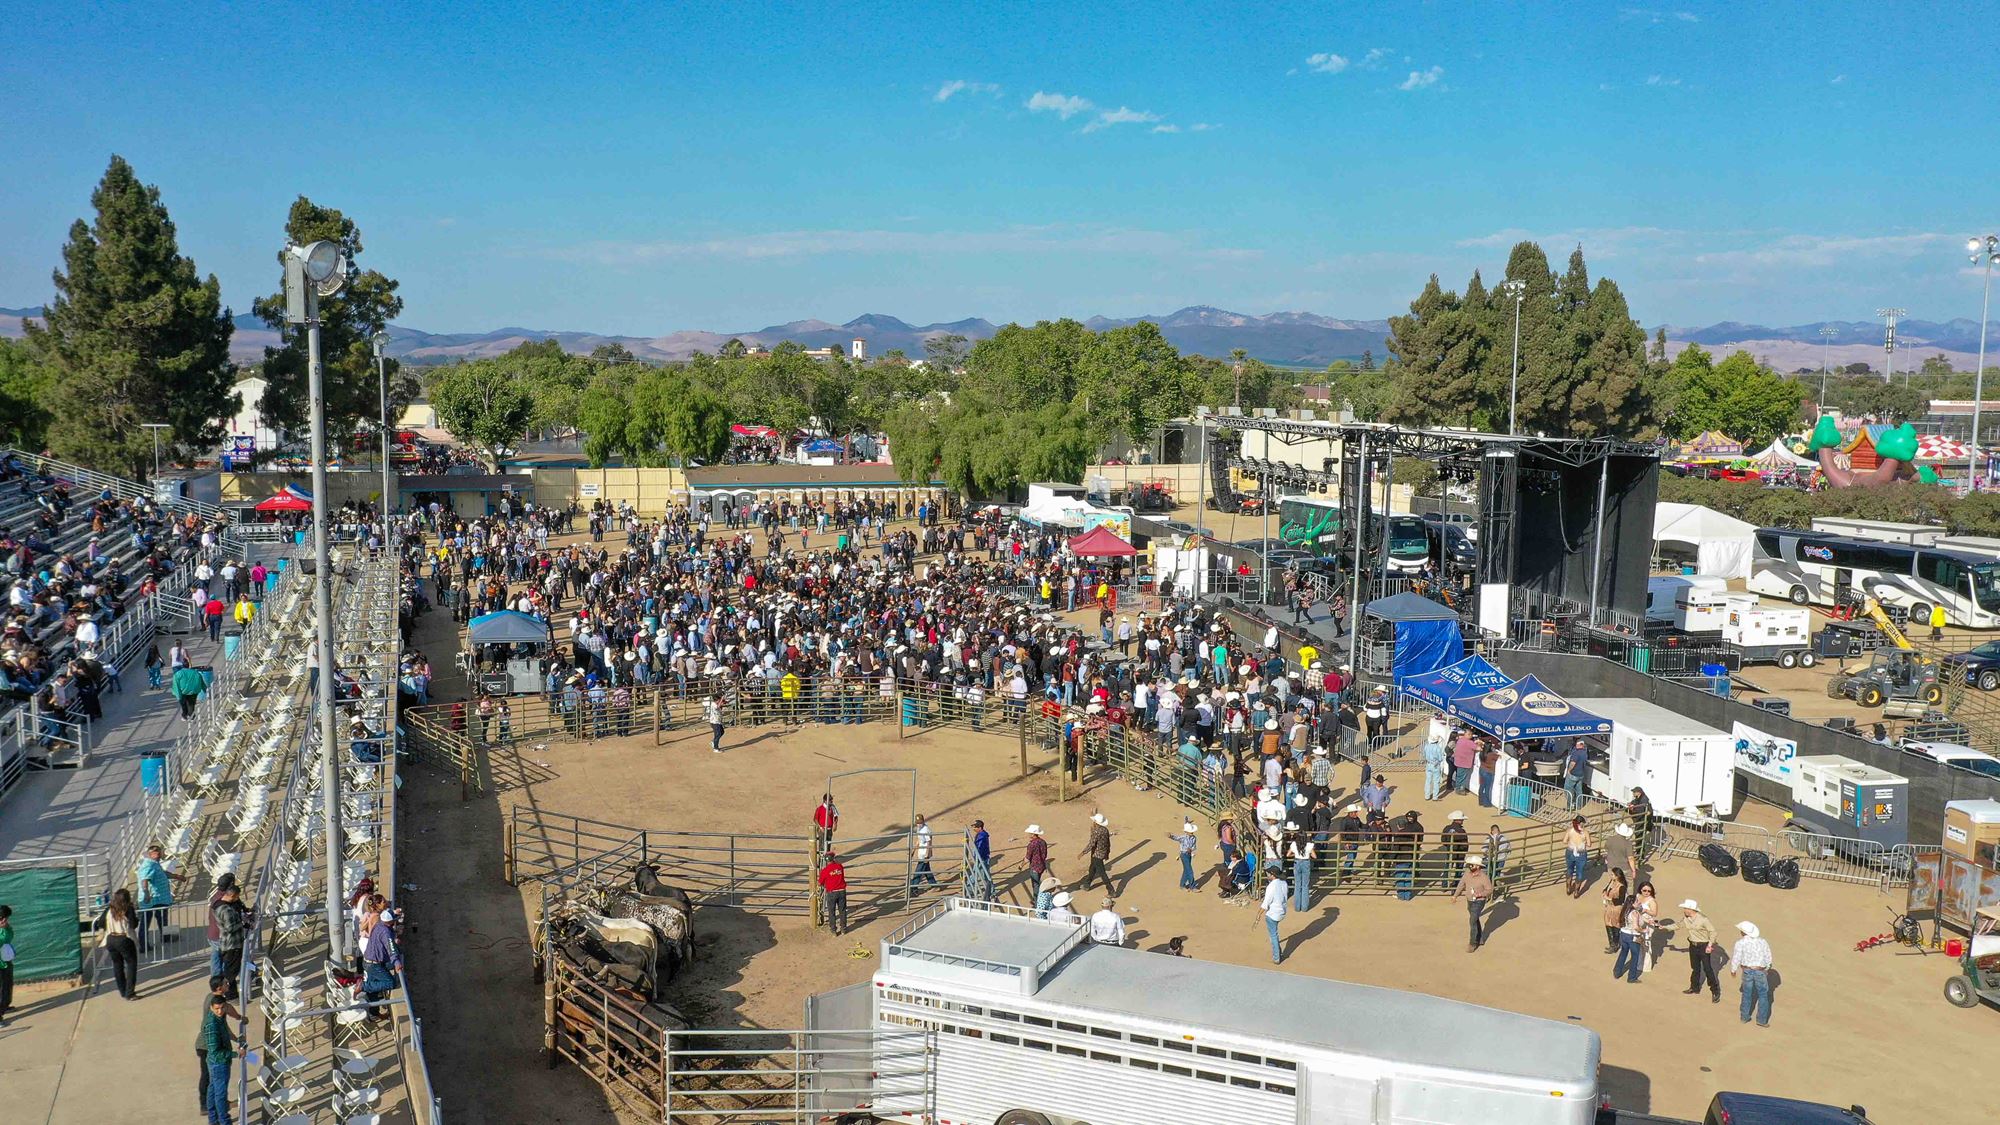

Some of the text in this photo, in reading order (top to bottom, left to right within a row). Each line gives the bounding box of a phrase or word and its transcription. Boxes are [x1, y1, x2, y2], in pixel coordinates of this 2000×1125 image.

[1884, 622, 1901, 640] GEHL
[1441, 669, 1464, 685] ULTRA
[1468, 676, 1508, 686] ULTRA
[1425, 692, 1444, 706] ULTRA
[1458, 710, 1477, 722] ESTRELLA
[1525, 726, 1561, 734] ESTRELLA
